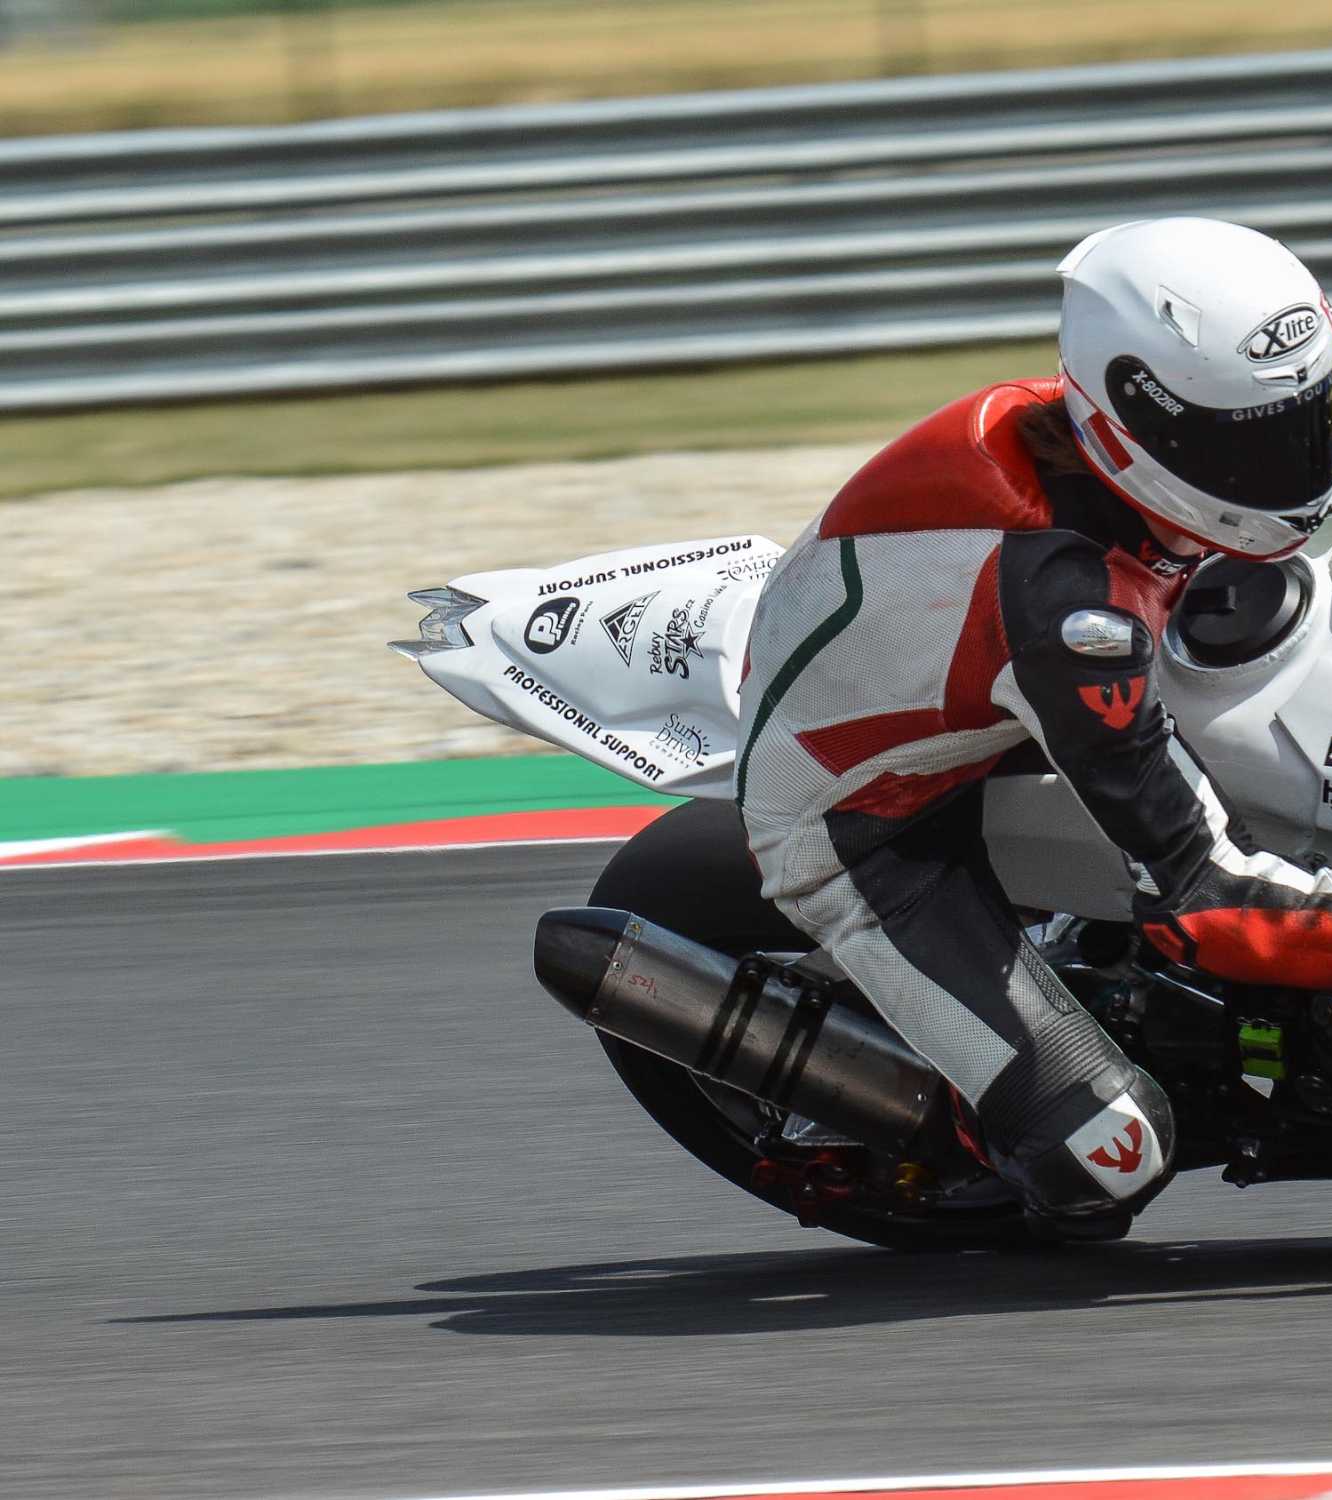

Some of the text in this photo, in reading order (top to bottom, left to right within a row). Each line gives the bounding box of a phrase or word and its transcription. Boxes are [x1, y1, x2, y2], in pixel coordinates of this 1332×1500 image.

[1260, 315, 1316, 358] X-lite
[1132, 371, 1184, 416] X-802RR
[1231, 403, 1286, 422] GIVES
[537, 538, 753, 597] PROFESSIONAL SUPPORT
[648, 631, 665, 675] Rebuy
[503, 665, 665, 781] PROFESSIONAL SUPPORT
[656, 726, 696, 761] Drive
